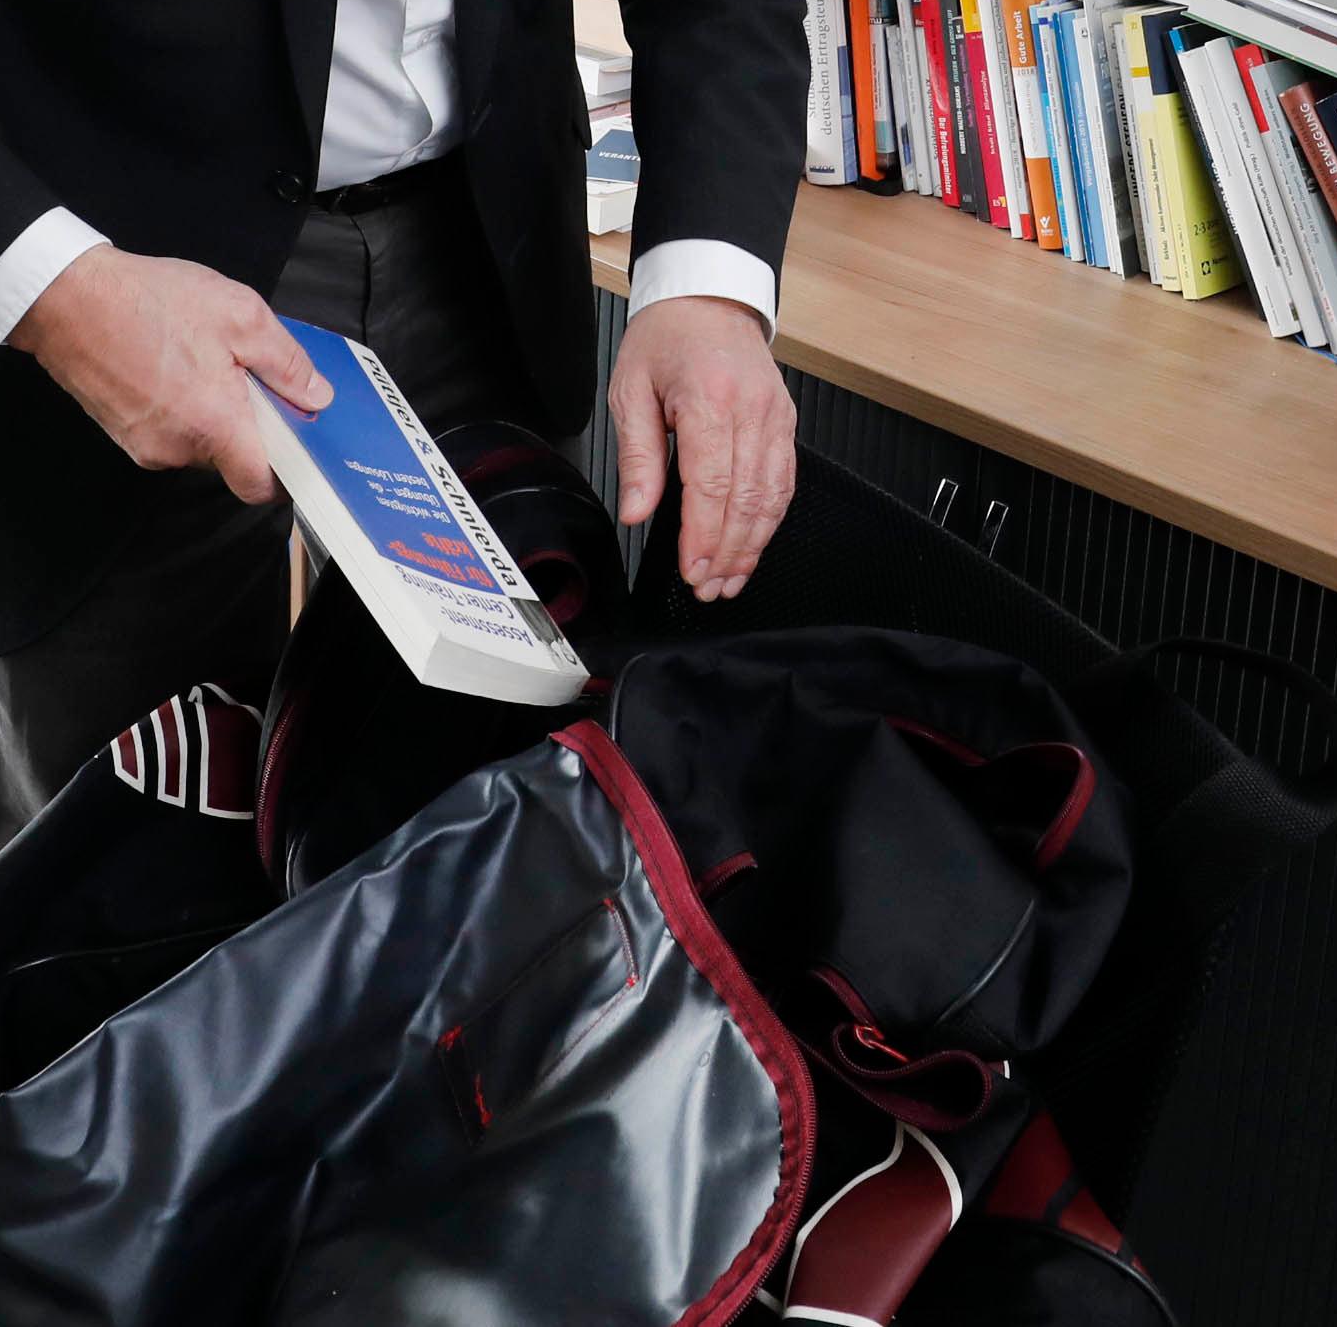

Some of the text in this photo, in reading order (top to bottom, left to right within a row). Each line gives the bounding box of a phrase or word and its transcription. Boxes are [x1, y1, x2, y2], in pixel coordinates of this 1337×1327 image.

[1012, 9, 1027, 63] Gute Arbeit
[817, 70, 832, 135] deutschen
[938, 117, 952, 194] Der Befreiungsminister
[343, 459, 428, 490] besten Lösungen
[363, 355, 518, 588] Püttjer & Schnierda
[367, 480, 440, 507] Übungen die
[375, 495, 450, 523] Die wichtigsten
[388, 540, 495, 588] für Führungs-
[421, 532, 475, 558] kräfte
[394, 565, 515, 620] Center-Training
[439, 606, 534, 647] Assessment-
